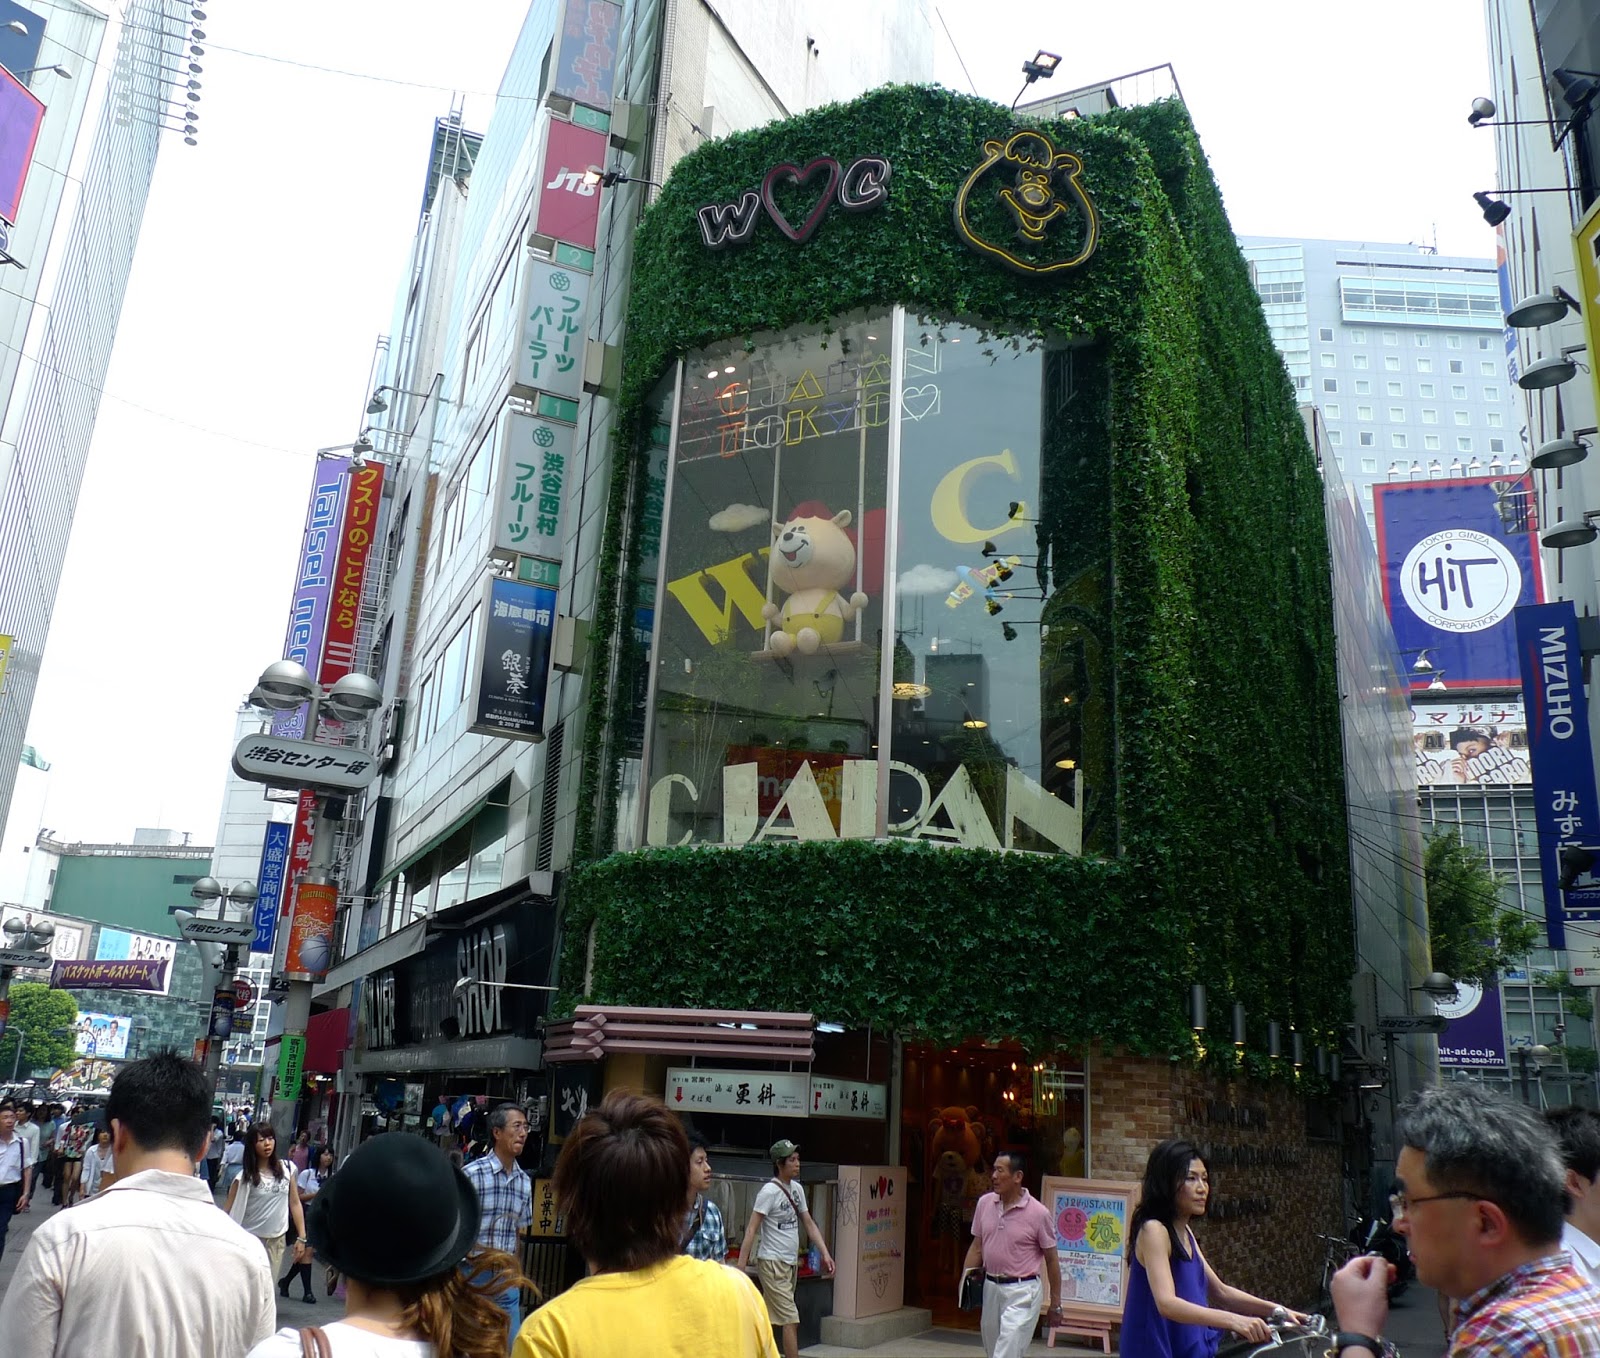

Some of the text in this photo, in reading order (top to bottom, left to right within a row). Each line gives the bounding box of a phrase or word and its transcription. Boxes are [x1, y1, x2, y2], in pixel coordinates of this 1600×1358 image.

[586, 111, 598, 125] 3
[547, 167, 596, 197] JTB
[569, 249, 582, 266] 2
[529, 305, 554, 379] パーラー
[555, 296, 581, 373] フルーツ
[554, 402, 561, 417] 1
[508, 462, 536, 543] フルーツ
[536, 451, 565, 537] 渋谷西村
[299, 472, 345, 590] Taisei
[1420, 531, 1491, 549] TOKYO GINZA
[336, 467, 378, 629] クスリのことなら
[529, 563, 550, 581] B1
[493, 599, 551, 627] 海底都市
[1428, 613, 1499, 630] CORPORATION
[1538, 626, 1574, 740] MIZUHO
[1425, 733, 1444, 749] AI
[244, 745, 370, 776] 渋谷センター街
[722, 759, 1084, 857] JAPAN
[254, 832, 287, 943] 大盛堂商事ビル
[185, 923, 253, 937] 渋谷センター街
[63, 964, 150, 982] バスケットボールストリート
[456, 924, 508, 1038] SHOP
[1508, 1035, 1534, 1047] レース
[283, 1038, 301, 1098] 客引きは犯罪です
[735, 1082, 776, 1107] 更科
[850, 1090, 870, 1112] 更科
[539, 1183, 554, 1234] 営業中
[1090, 1222, 1120, 1242] 70%
